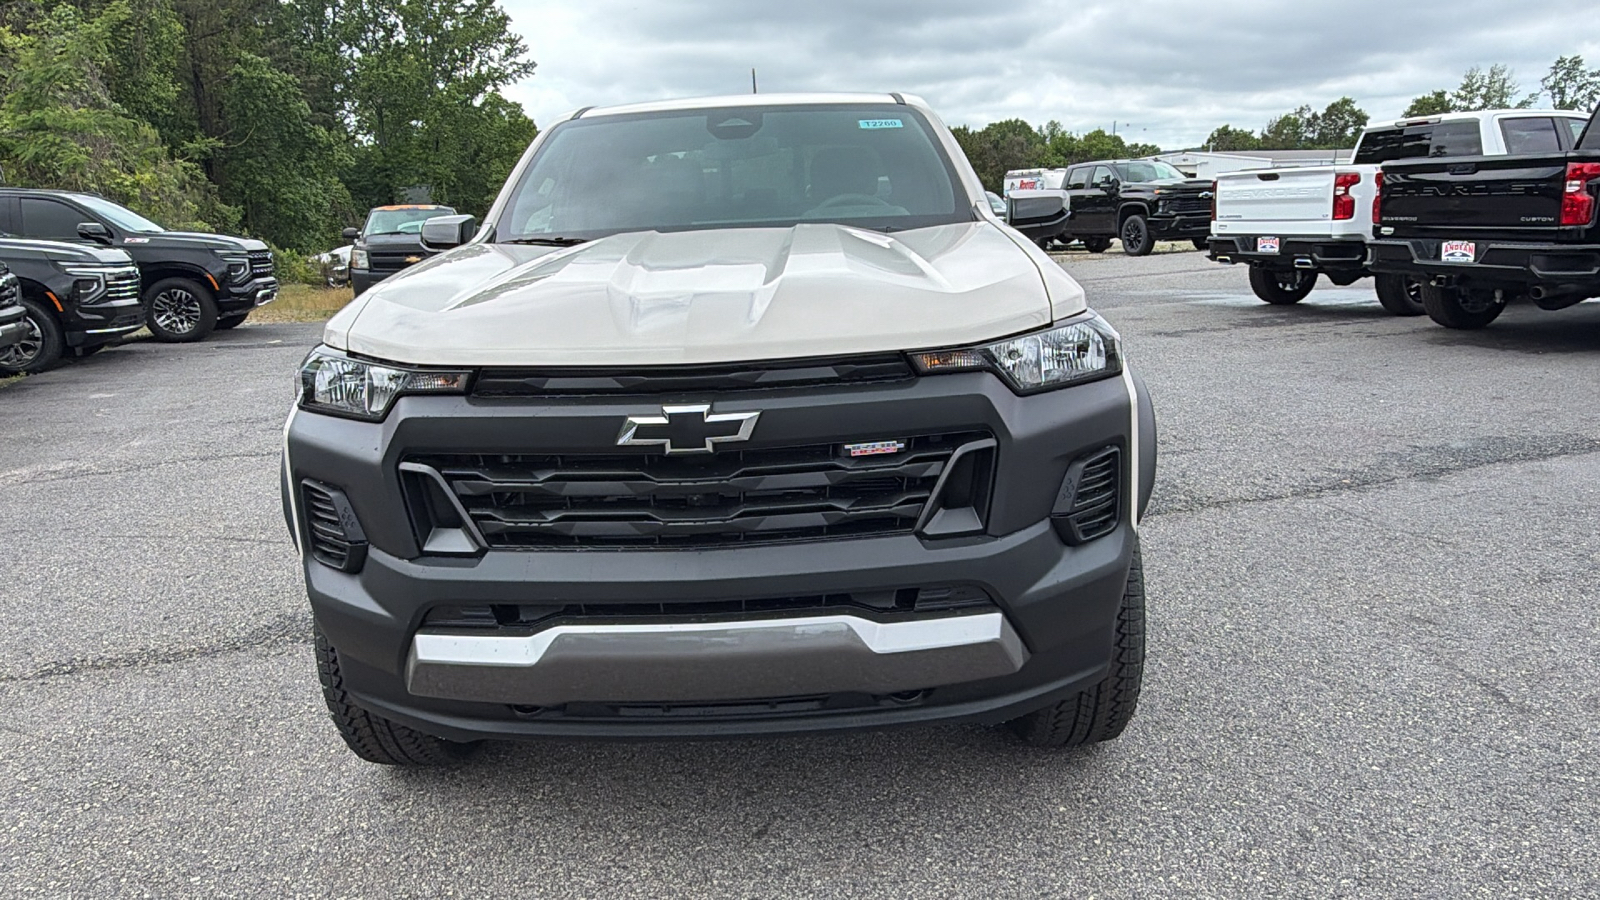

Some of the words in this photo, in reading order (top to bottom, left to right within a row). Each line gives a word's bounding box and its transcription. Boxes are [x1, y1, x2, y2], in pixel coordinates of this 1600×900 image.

[1221, 187, 1323, 199] CHEVROLET
[1390, 184, 1548, 197] CHEVROLET
[1444, 244, 1475, 254] ANDEAN
